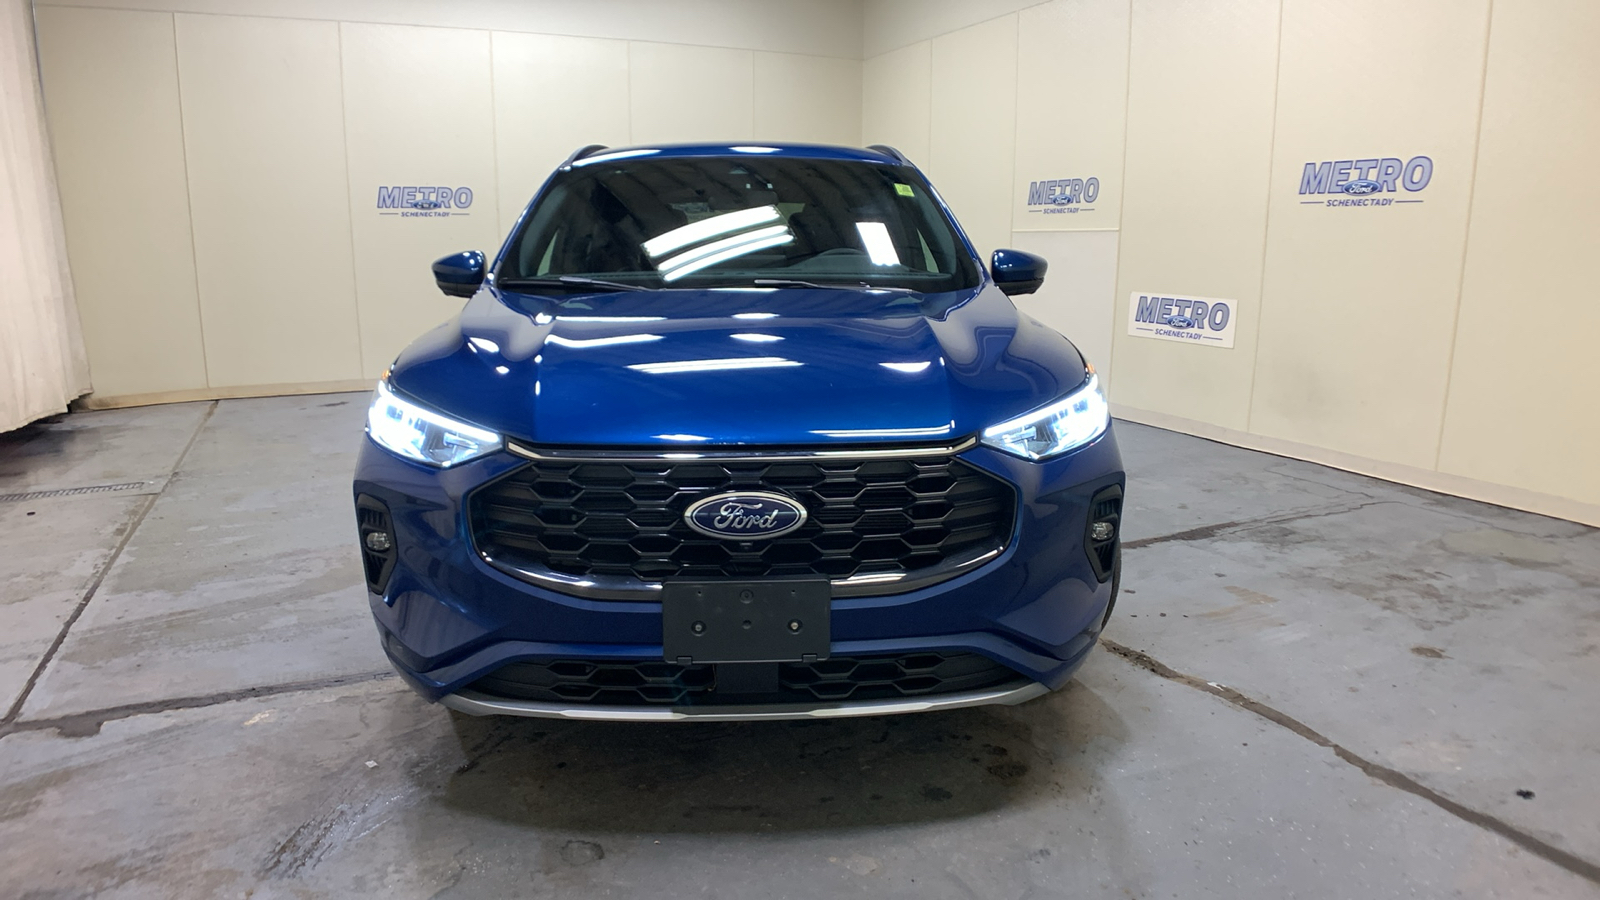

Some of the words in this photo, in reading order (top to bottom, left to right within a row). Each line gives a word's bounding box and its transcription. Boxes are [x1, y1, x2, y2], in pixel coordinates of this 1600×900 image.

[1299, 156, 1433, 194] METRO
[1349, 182, 1372, 193] Ford
[377, 186, 473, 209] METRO
[1028, 177, 1099, 205] METRO
[1326, 198, 1394, 207] SCHENECTADY
[1135, 296, 1230, 331] METRO
[1155, 328, 1203, 340] SCHENECTADY
[714, 502, 779, 529] Ford
